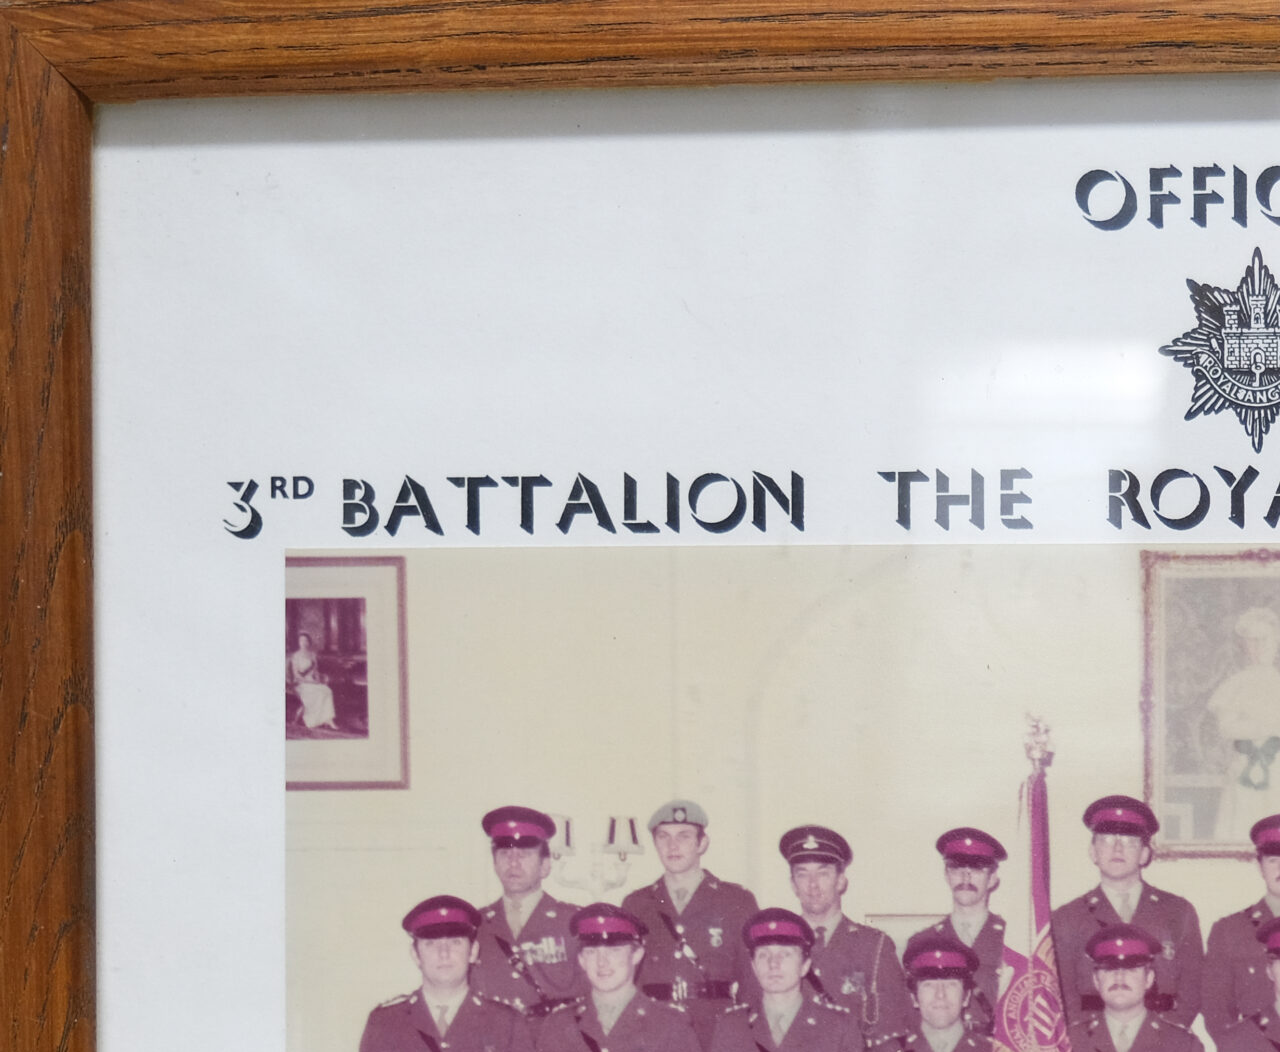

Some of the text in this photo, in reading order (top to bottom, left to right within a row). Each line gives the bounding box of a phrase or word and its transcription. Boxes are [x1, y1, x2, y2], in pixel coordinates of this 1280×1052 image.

[1202, 358, 1239, 399] ROYAL
[340, 469, 805, 538] BATTALION
[876, 467, 1034, 532] THE
